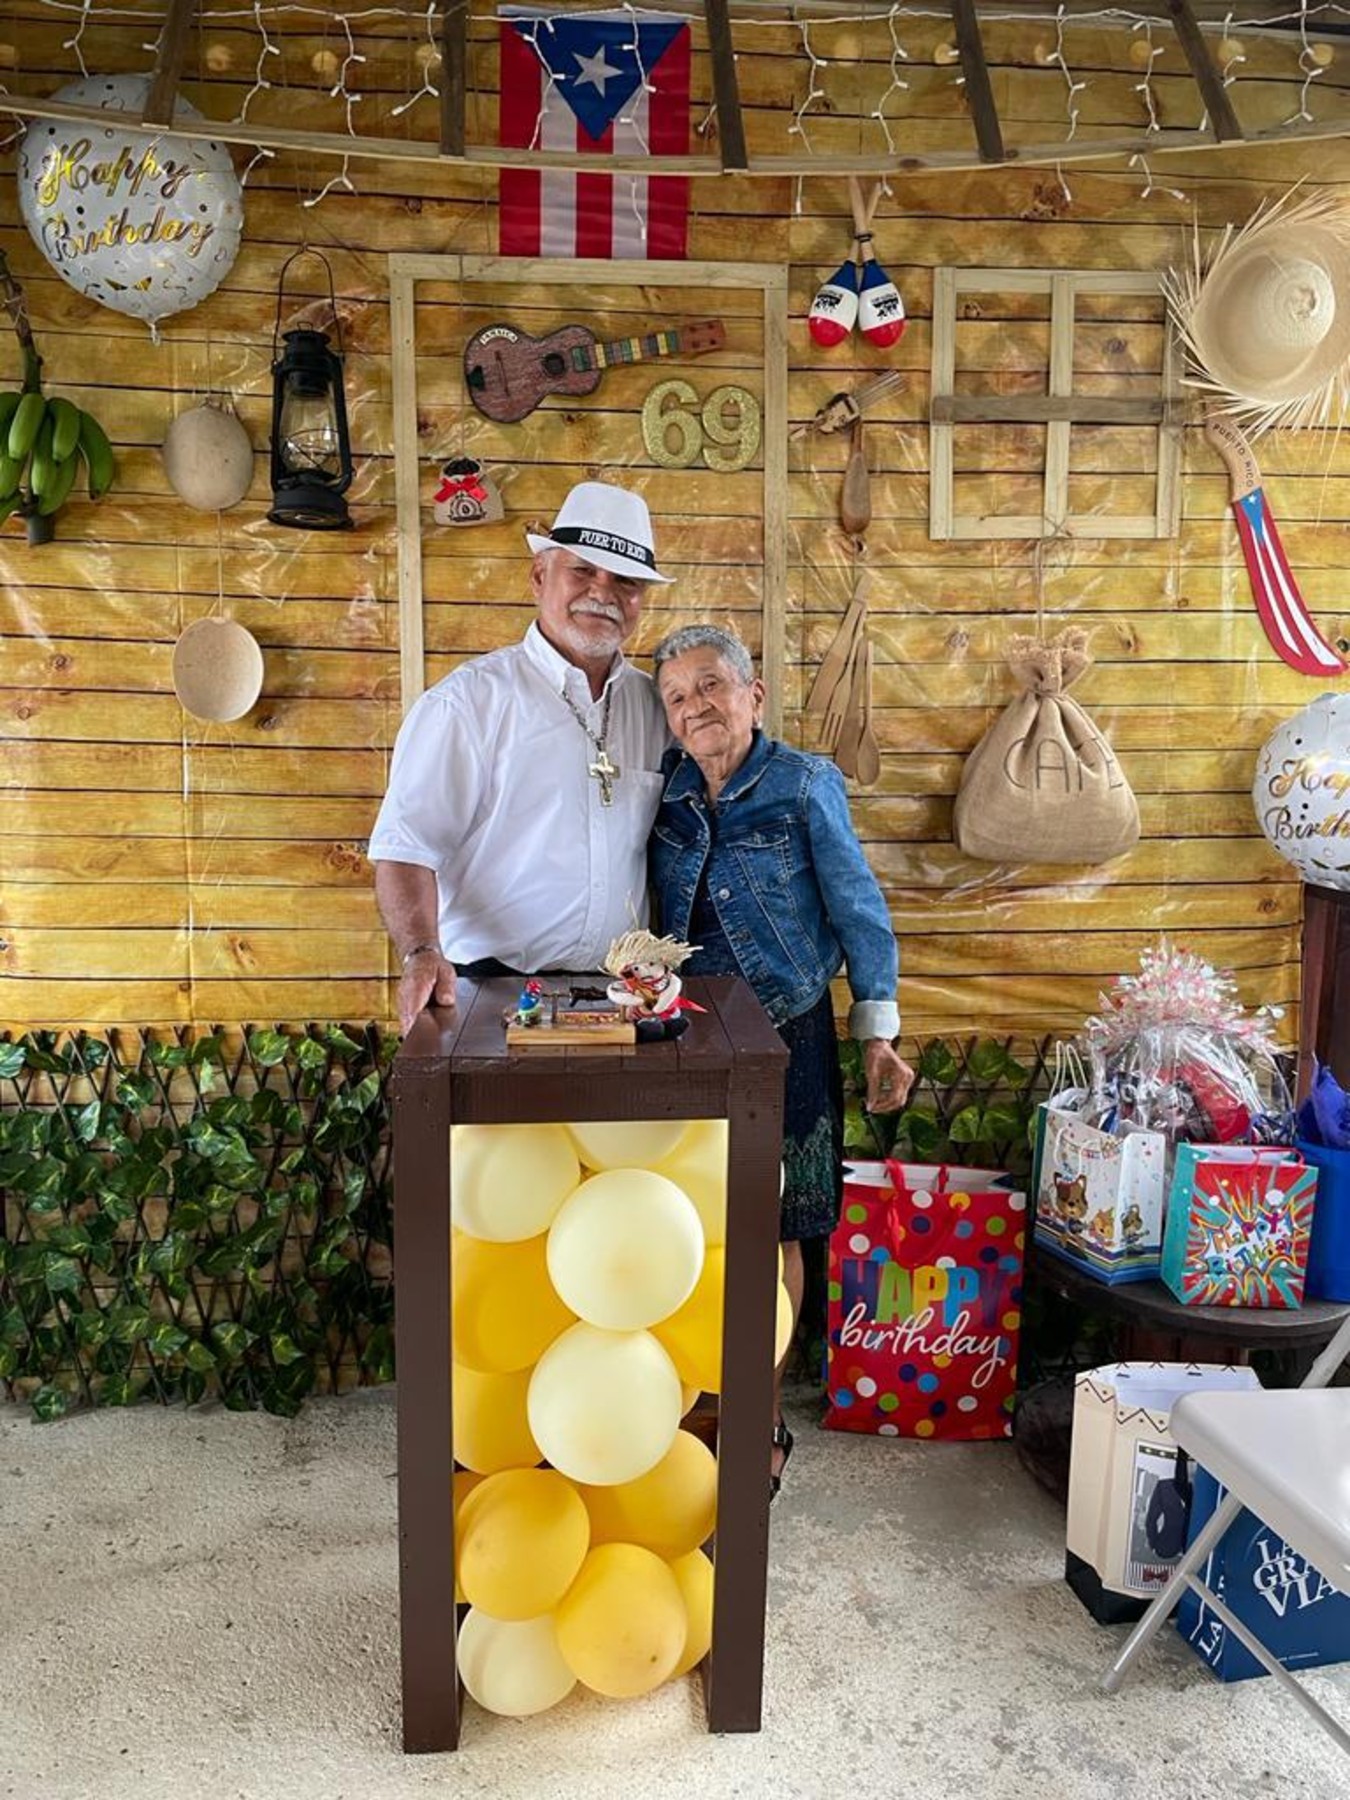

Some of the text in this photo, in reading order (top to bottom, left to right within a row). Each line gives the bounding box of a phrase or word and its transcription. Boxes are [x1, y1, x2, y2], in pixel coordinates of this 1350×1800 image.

[37, 138, 194, 207] Happy
[42, 206, 214, 262] Birthday
[641, 378, 761, 472] 69
[578, 530, 627, 553] PUERTO
[841, 1259, 1009, 1328] HAPPY
[840, 1303, 1006, 1389] birthday
